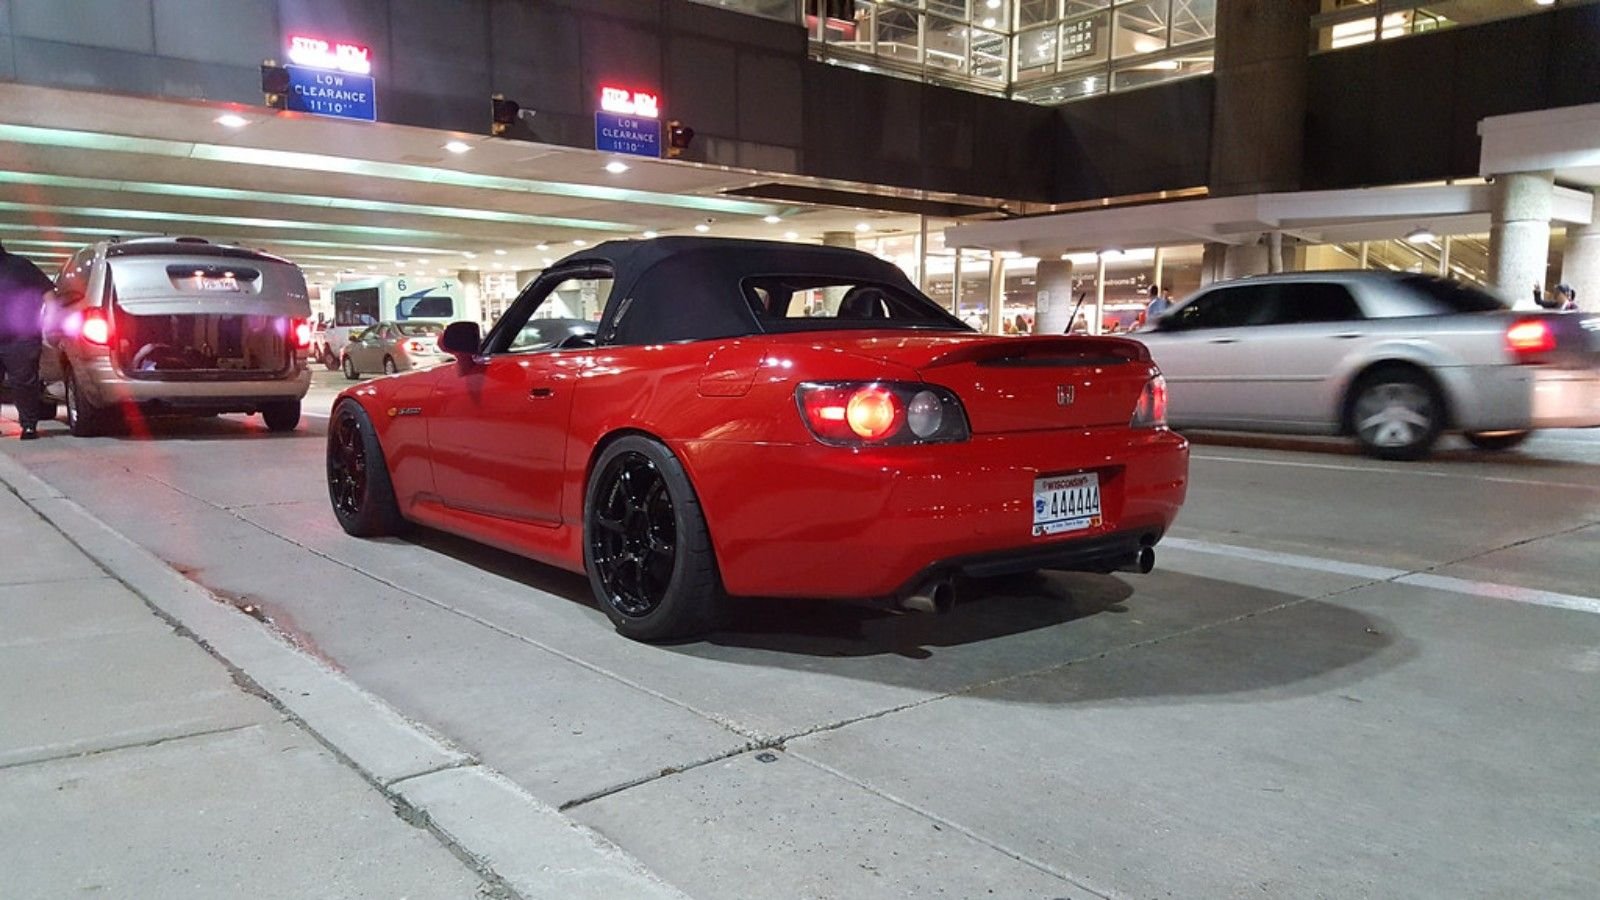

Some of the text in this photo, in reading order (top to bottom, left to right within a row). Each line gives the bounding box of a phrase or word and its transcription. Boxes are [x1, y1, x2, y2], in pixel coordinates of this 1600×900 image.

[316, 74, 344, 86] LOW
[295, 85, 366, 103] CLEARANCE
[618, 118, 638, 129] LOW
[602, 128, 655, 143] CLEARANCE
[398, 280, 407, 291] 6
[1051, 486, 1099, 517] 444444
